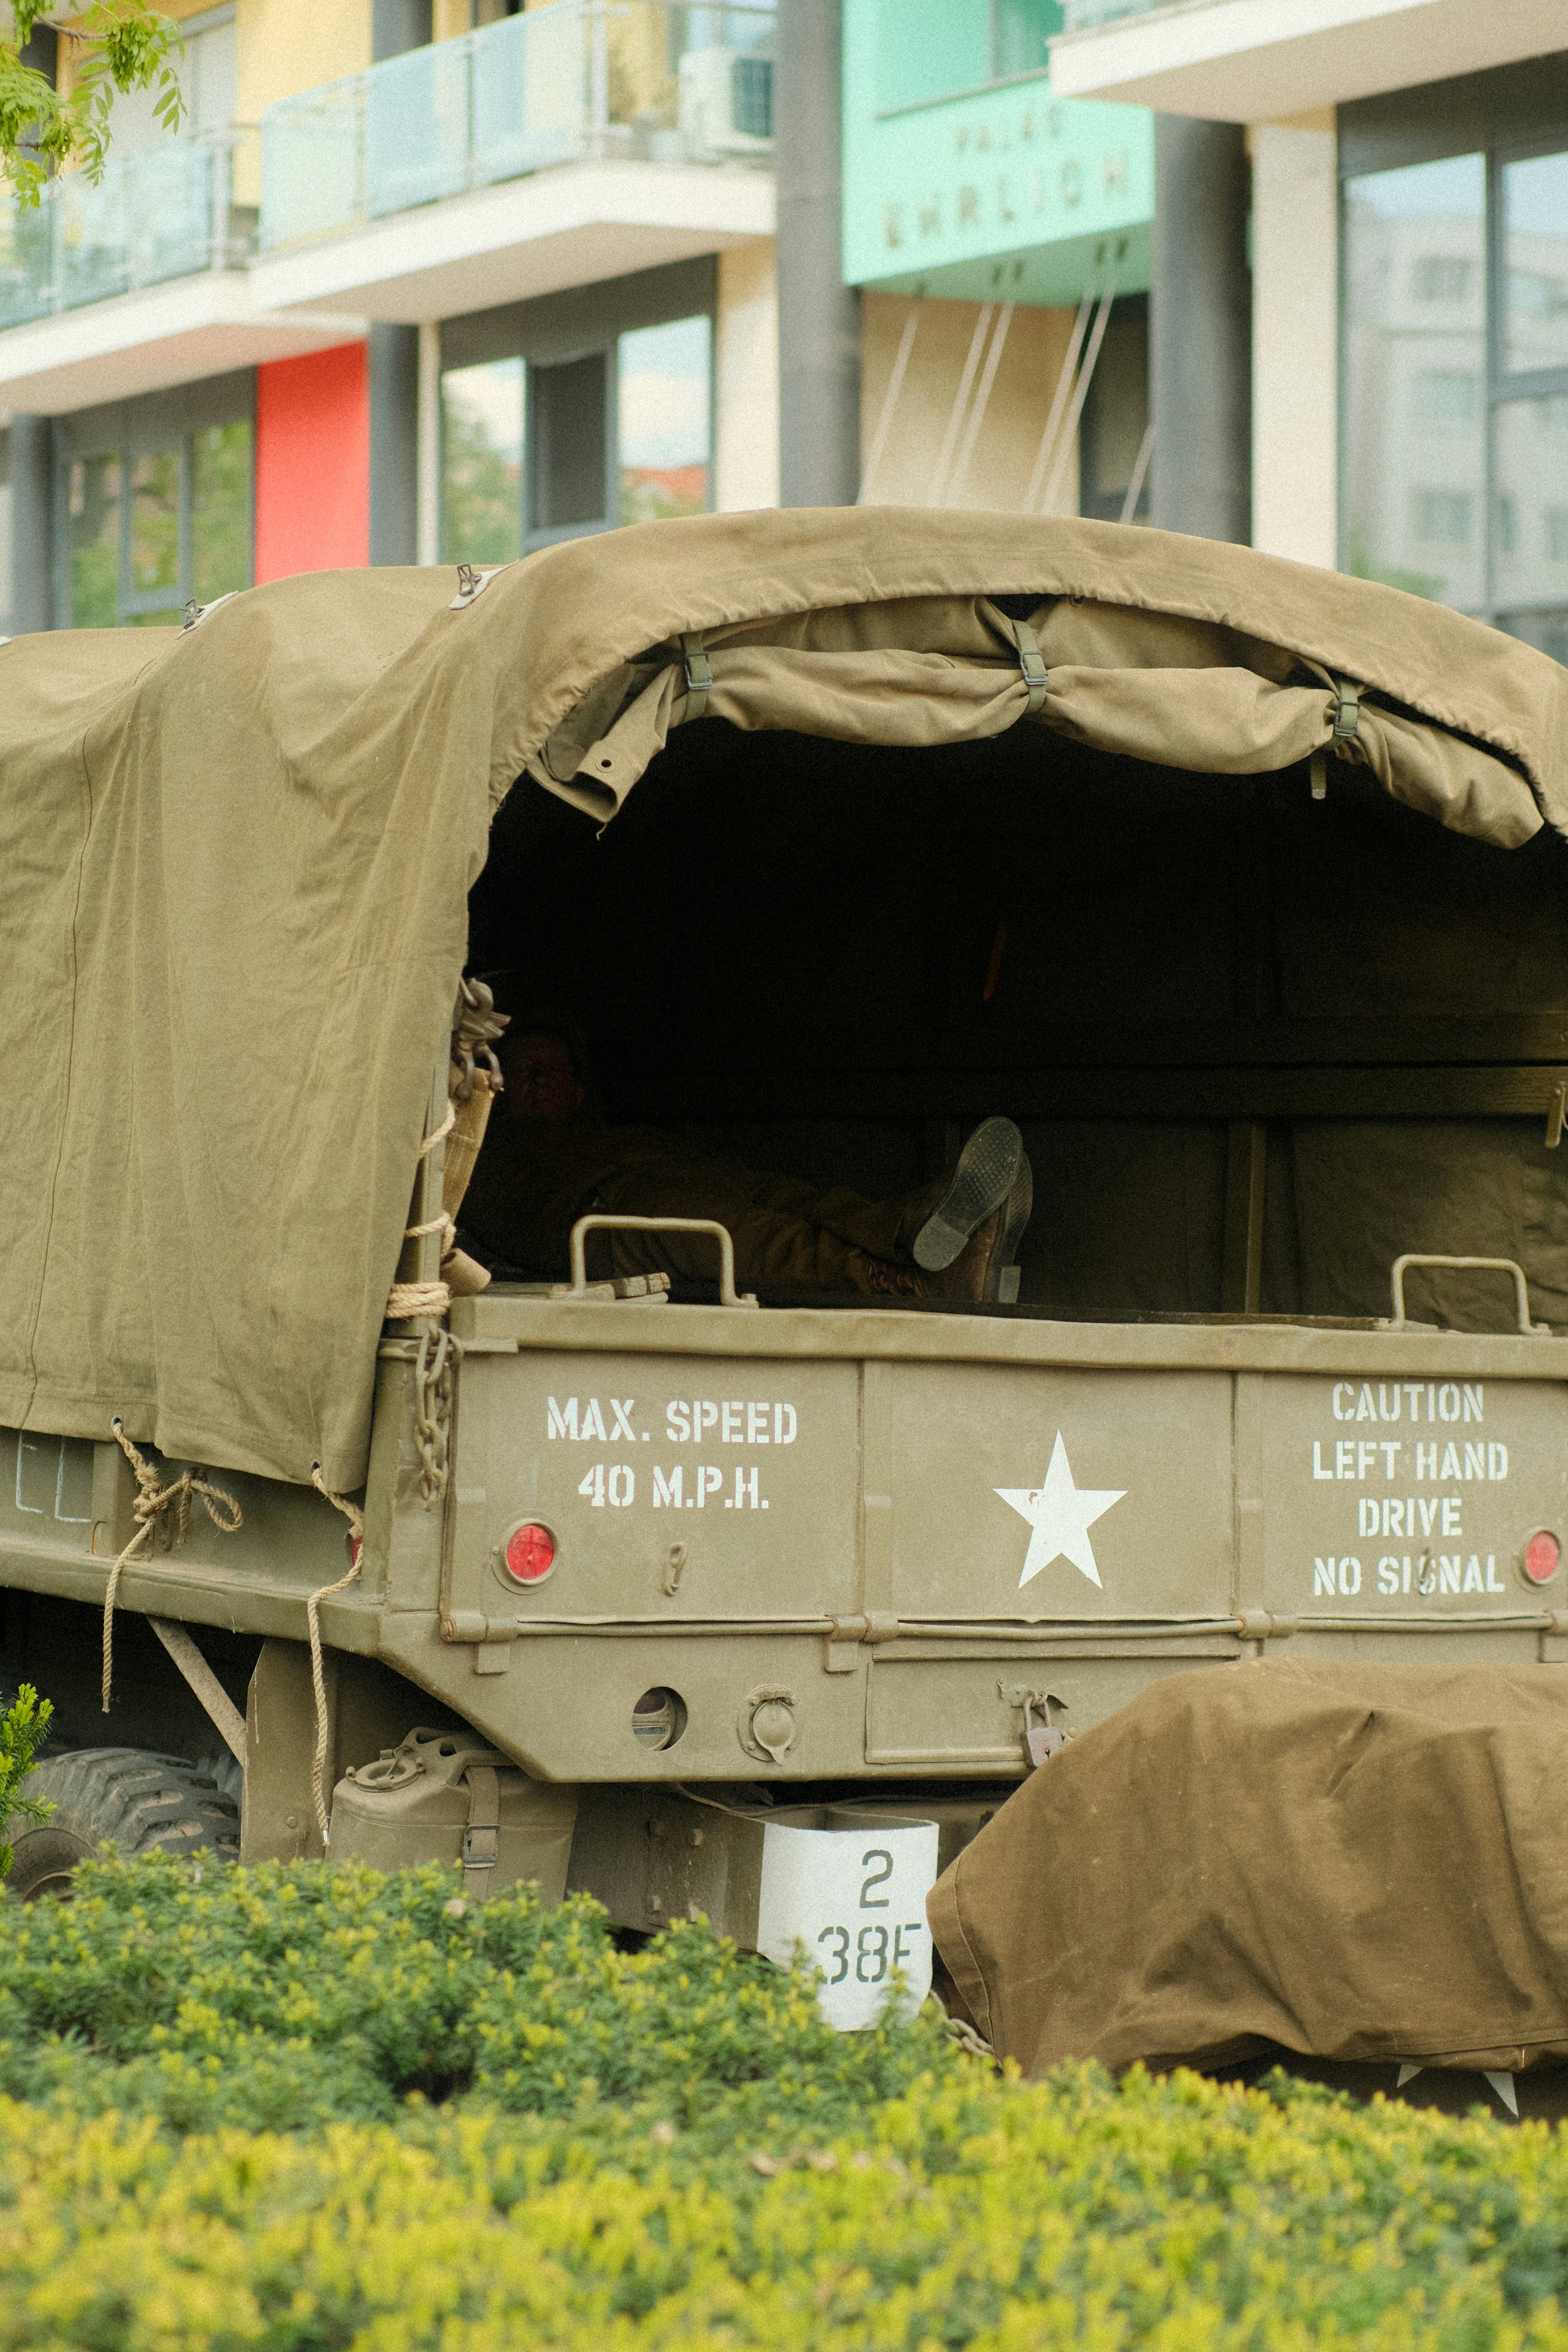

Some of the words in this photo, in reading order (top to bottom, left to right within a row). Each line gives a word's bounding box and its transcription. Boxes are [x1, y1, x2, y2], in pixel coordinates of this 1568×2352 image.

[548, 1396, 649, 1441] MAX.
[667, 1401, 797, 1444] SPEED
[1332, 1383, 1483, 1423] CAUTION
[1313, 1441, 1401, 1479] LEFT
[1416, 1442, 1507, 1480] HAND
[578, 1464, 635, 1506] 40
[653, 1466, 769, 1508] M.P.H.
[1359, 1498, 1461, 1536] DRIVE
[1314, 1557, 1361, 1596] NO
[1378, 1555, 1504, 1594] SIGNAL
[860, 1849, 893, 1908] 2
